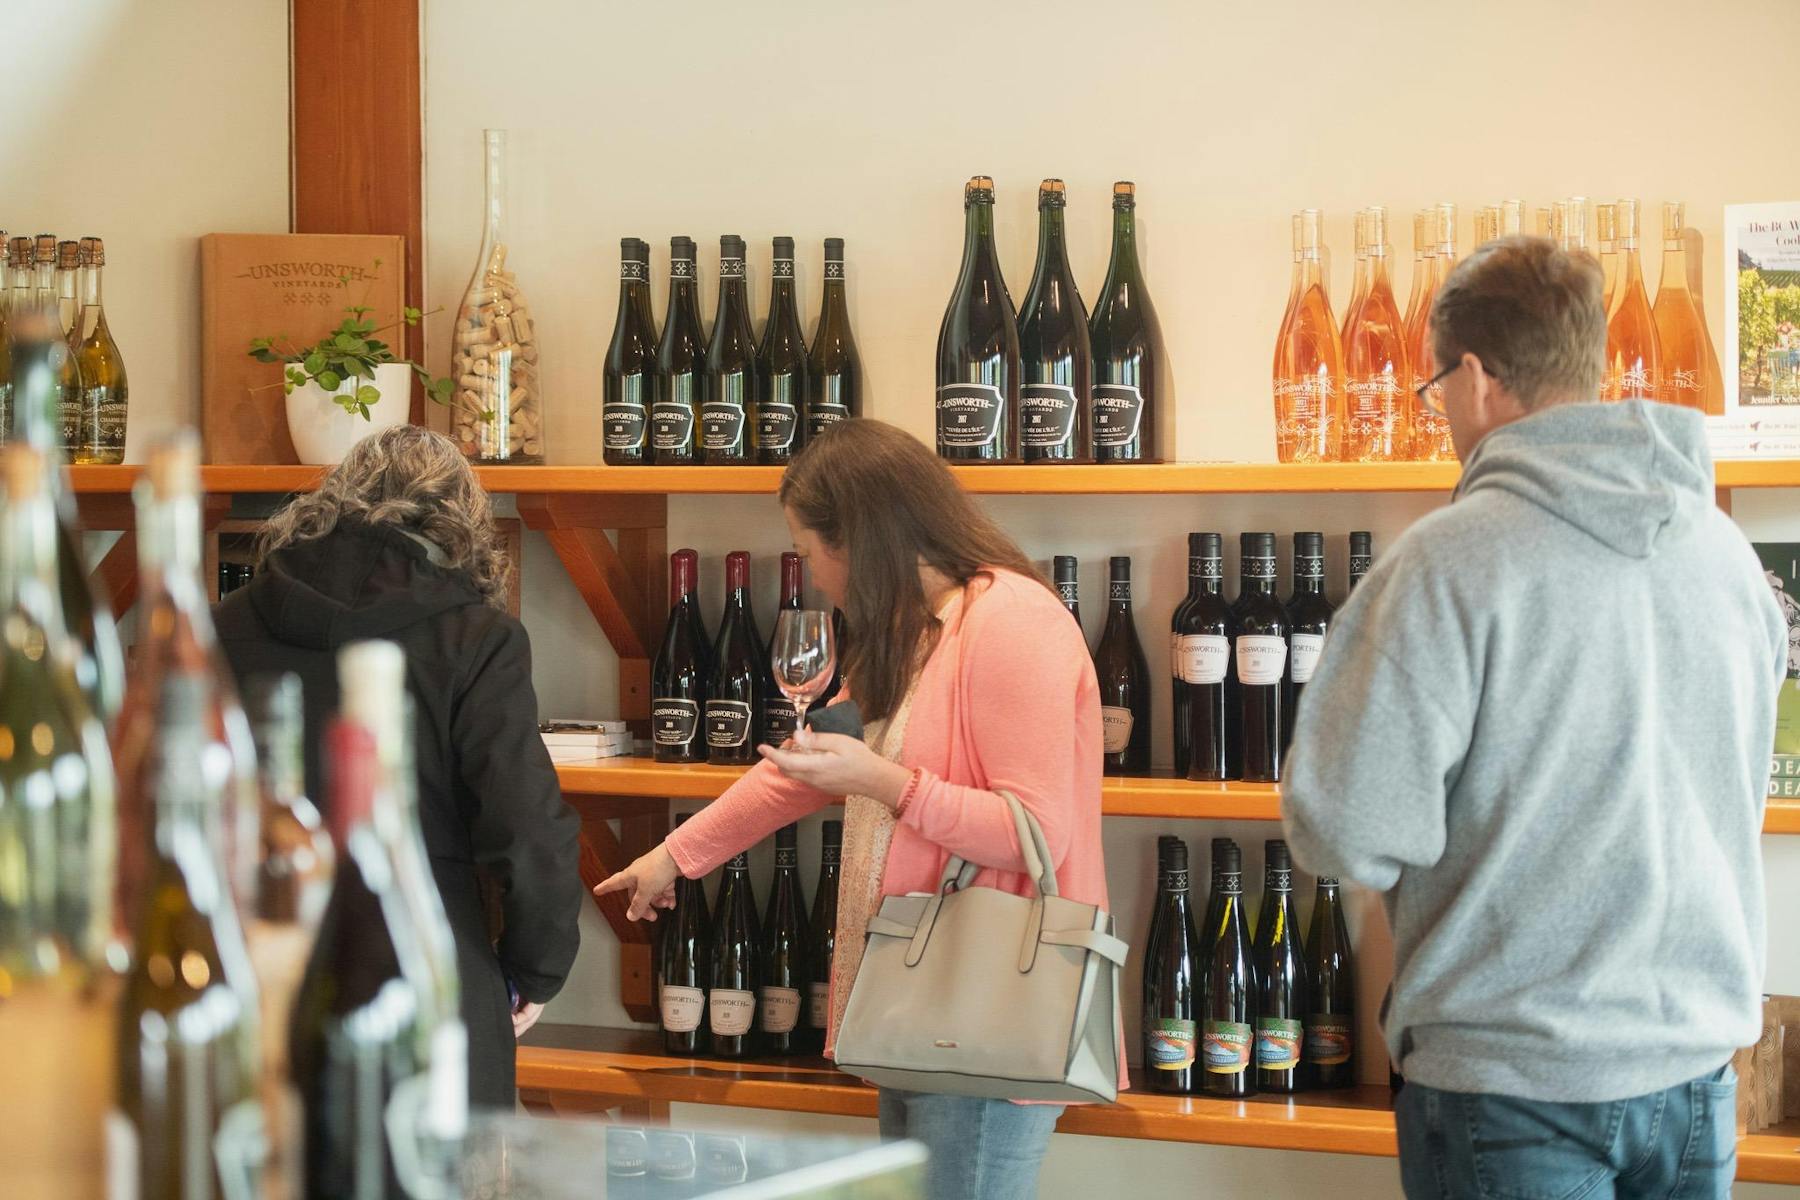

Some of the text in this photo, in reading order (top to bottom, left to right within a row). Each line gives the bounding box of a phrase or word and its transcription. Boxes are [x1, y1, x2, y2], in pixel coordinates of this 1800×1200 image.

[1776, 234, 1800, 245] Coo
[249, 262, 365, 281] UNSWORTH
[944, 397, 989, 408] UNSWORTH
